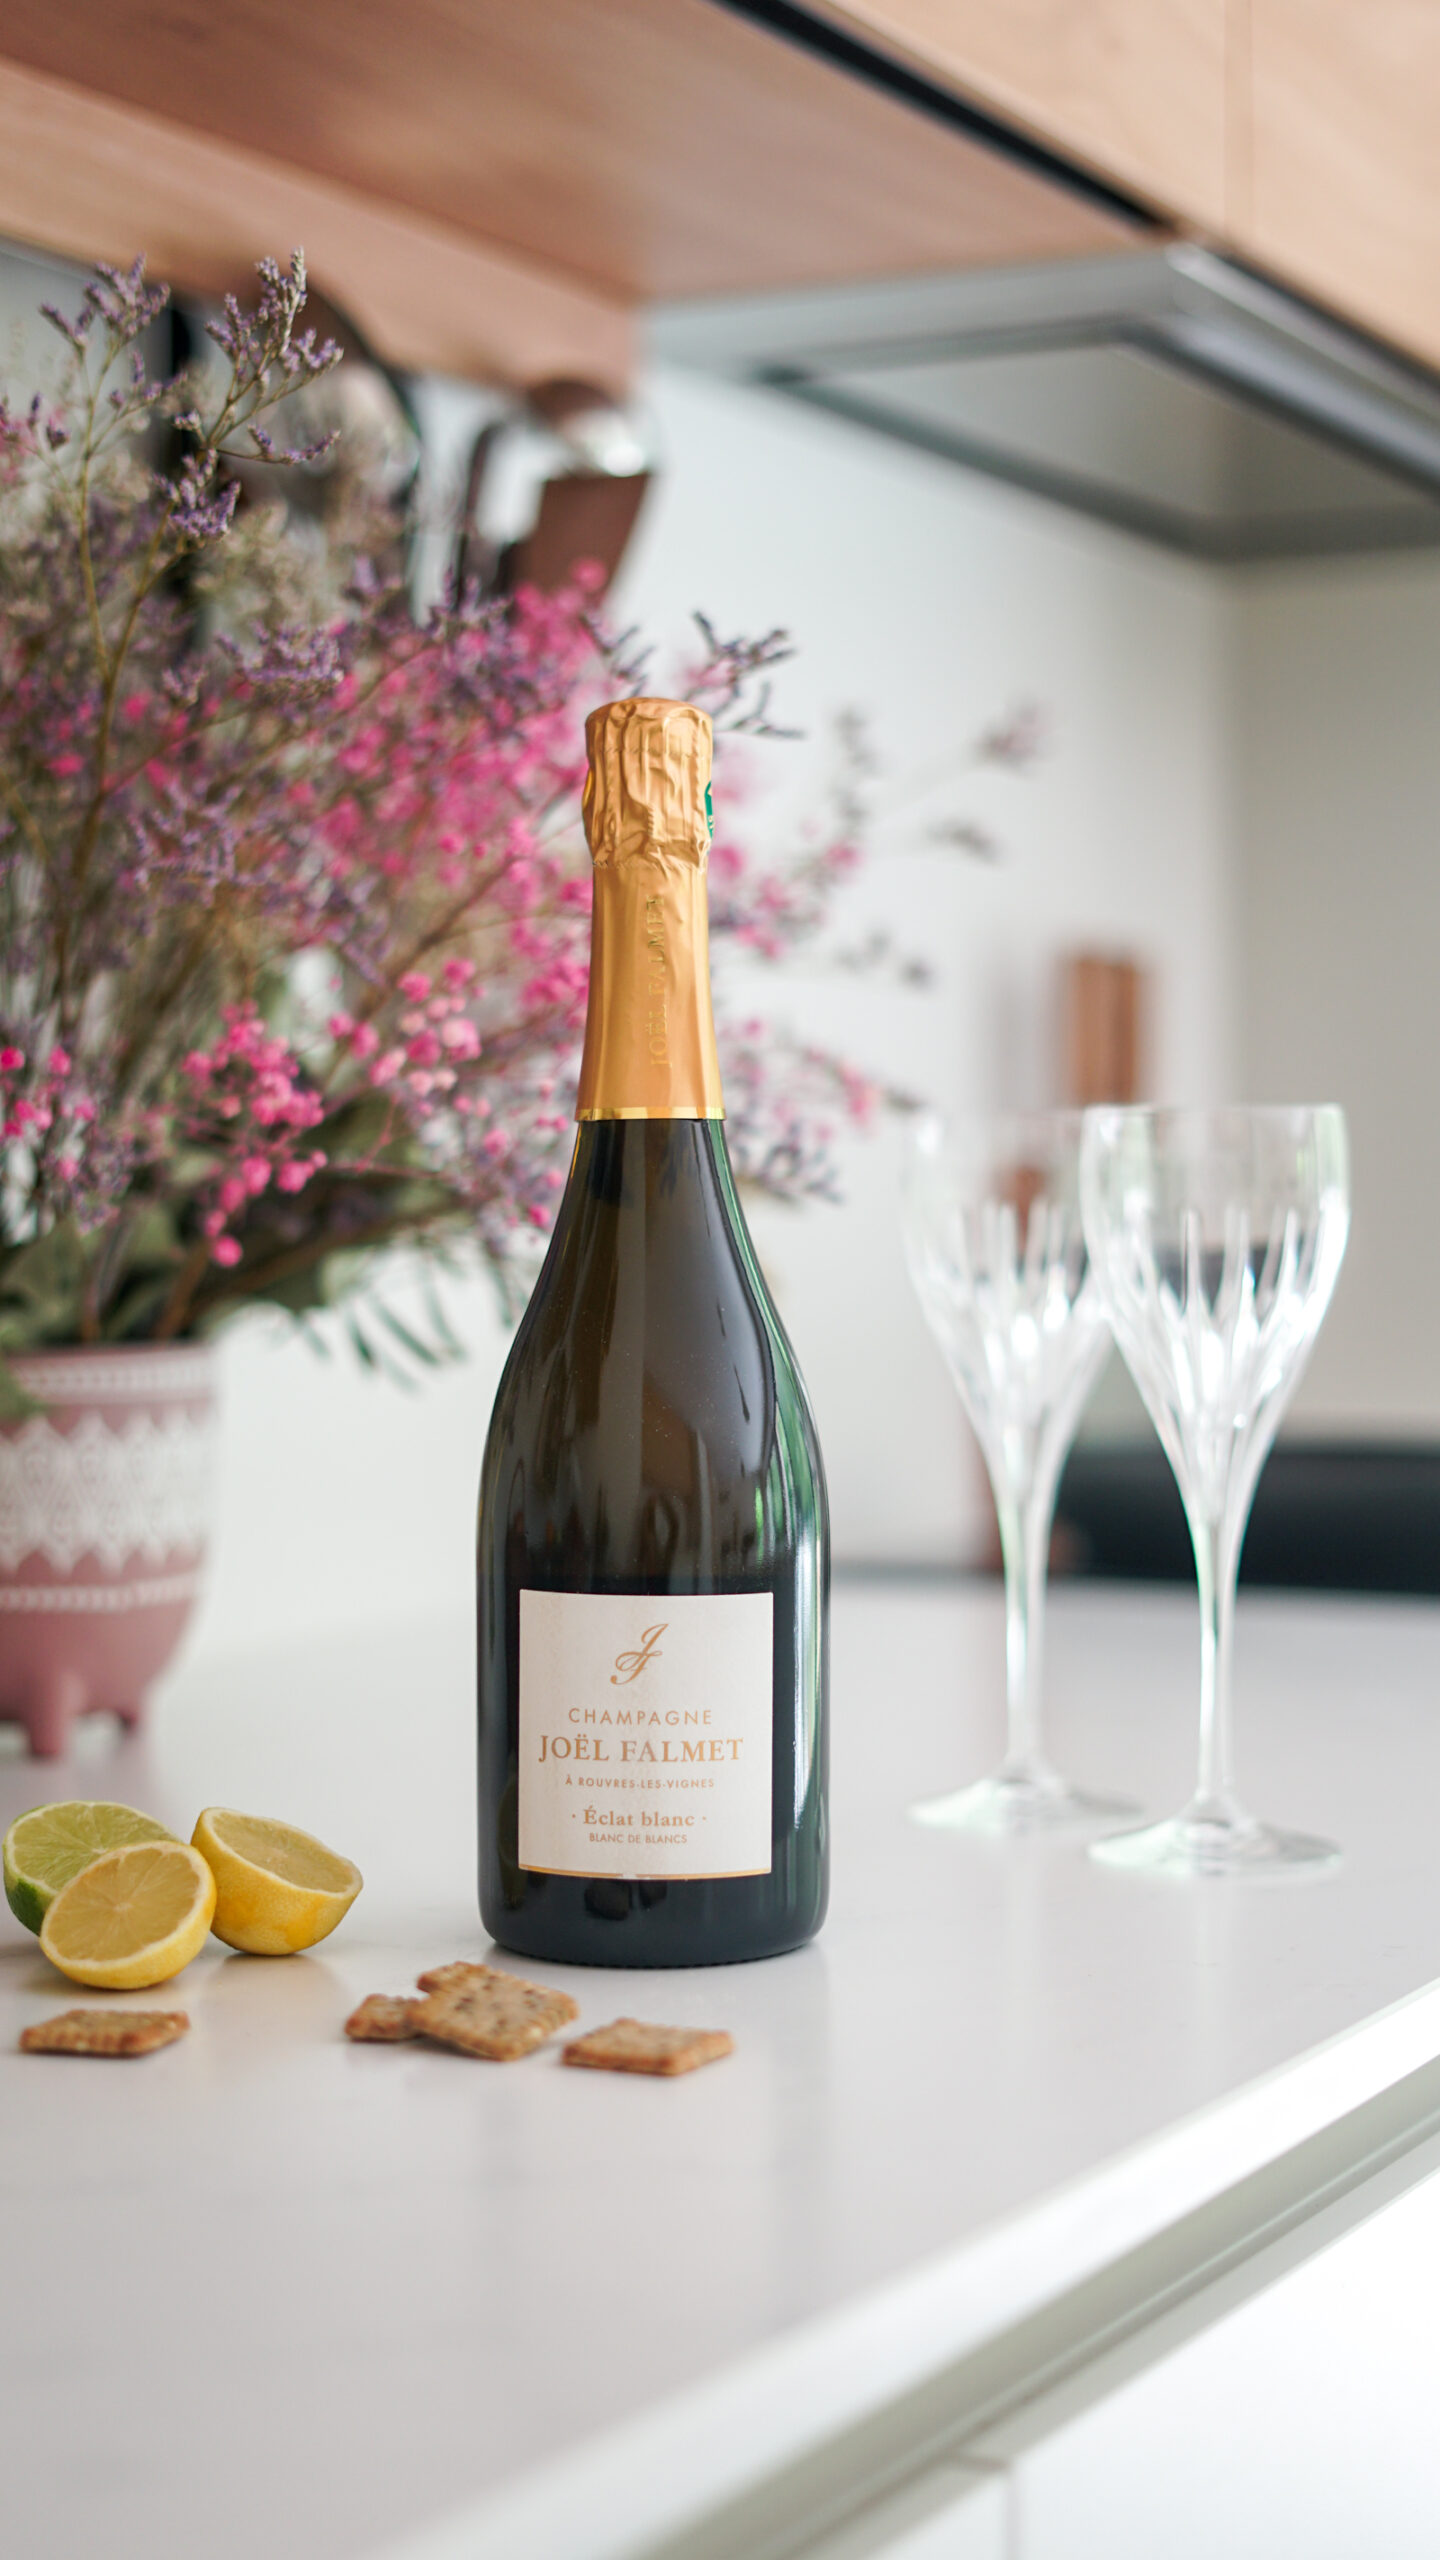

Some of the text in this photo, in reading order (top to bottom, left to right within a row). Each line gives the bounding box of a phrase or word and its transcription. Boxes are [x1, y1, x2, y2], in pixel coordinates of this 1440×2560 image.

[647, 894, 666, 996] FALMET
[568, 1707, 712, 1726] CHAMPAGNE
[538, 1733, 744, 1763] JOËL FALMET
[565, 1775, 573, 1785] À
[583, 1805, 695, 1827] Éclat blanc
[589, 1832, 687, 1844] BLANC DE BLANCS
